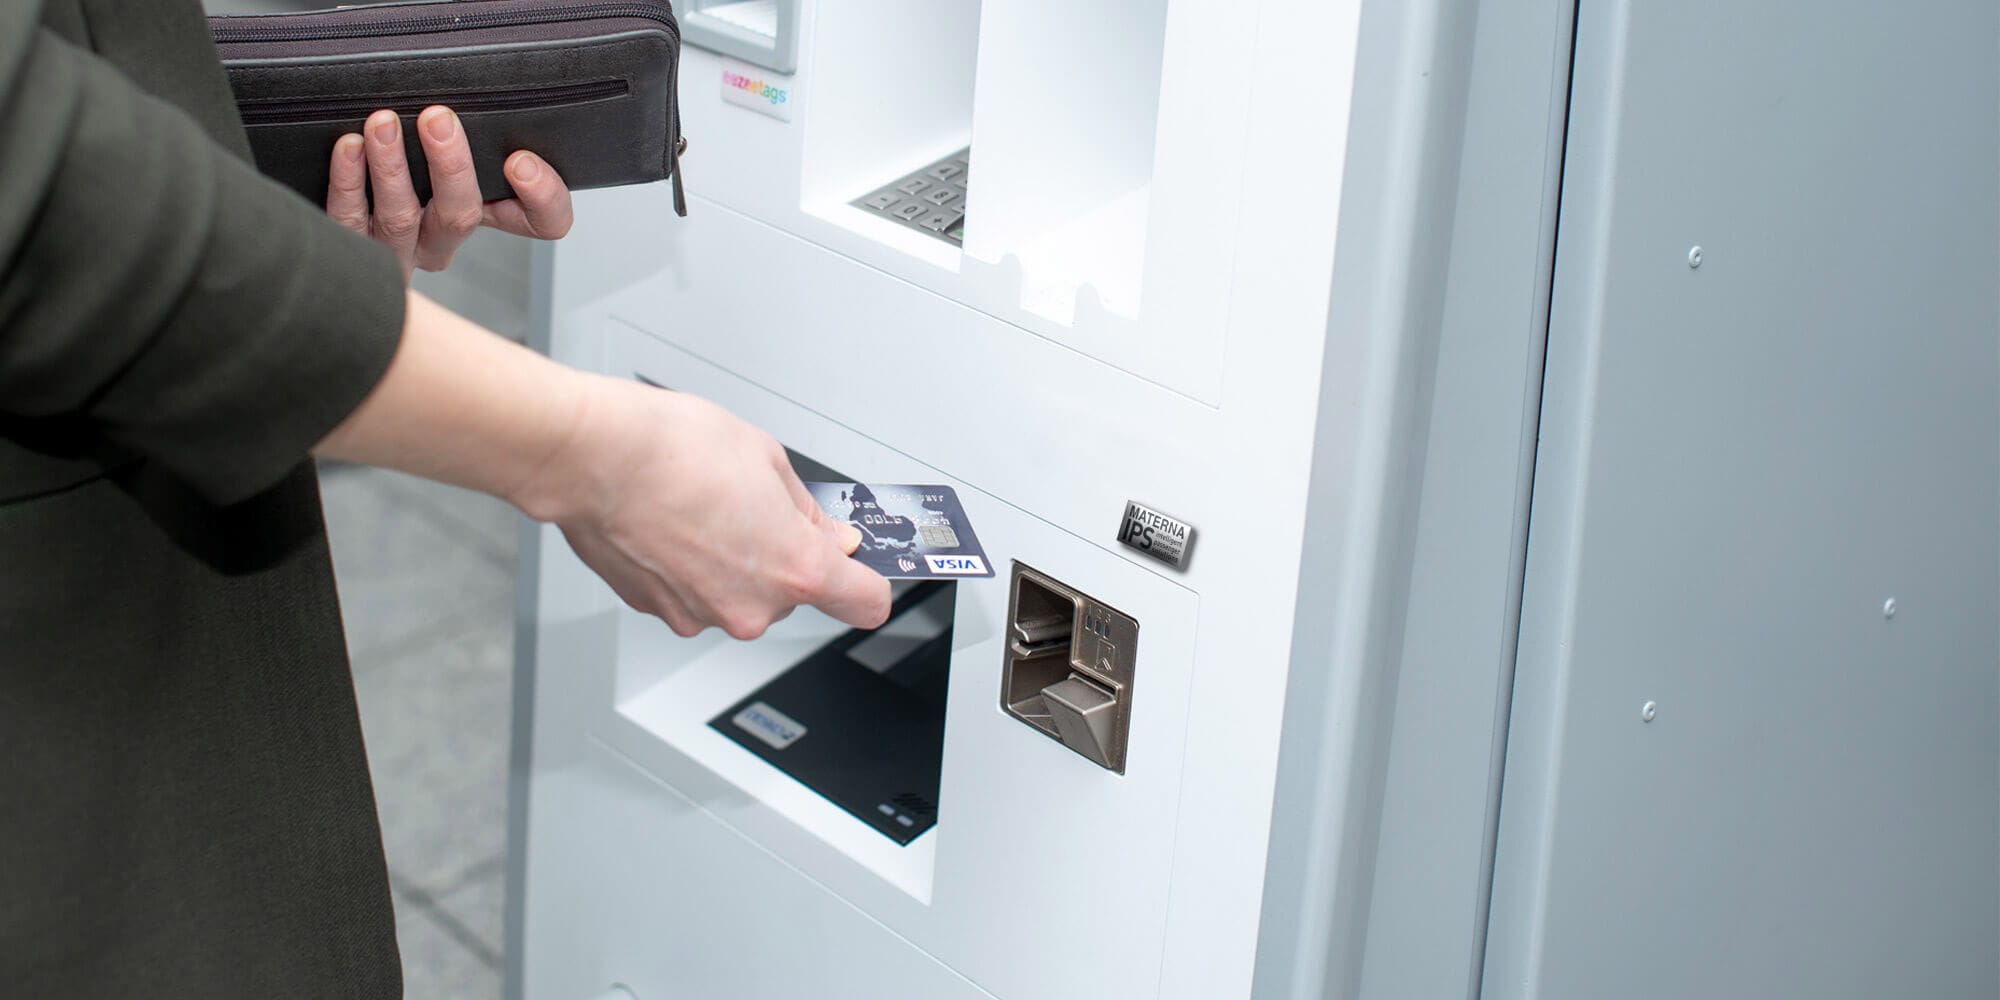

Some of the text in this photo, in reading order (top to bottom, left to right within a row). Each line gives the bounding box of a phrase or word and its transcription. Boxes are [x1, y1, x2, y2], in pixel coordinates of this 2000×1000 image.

[1122, 518, 1155, 549] IPS
[1129, 505, 1185, 539] MATERNA
[933, 559, 977, 569] VISA
